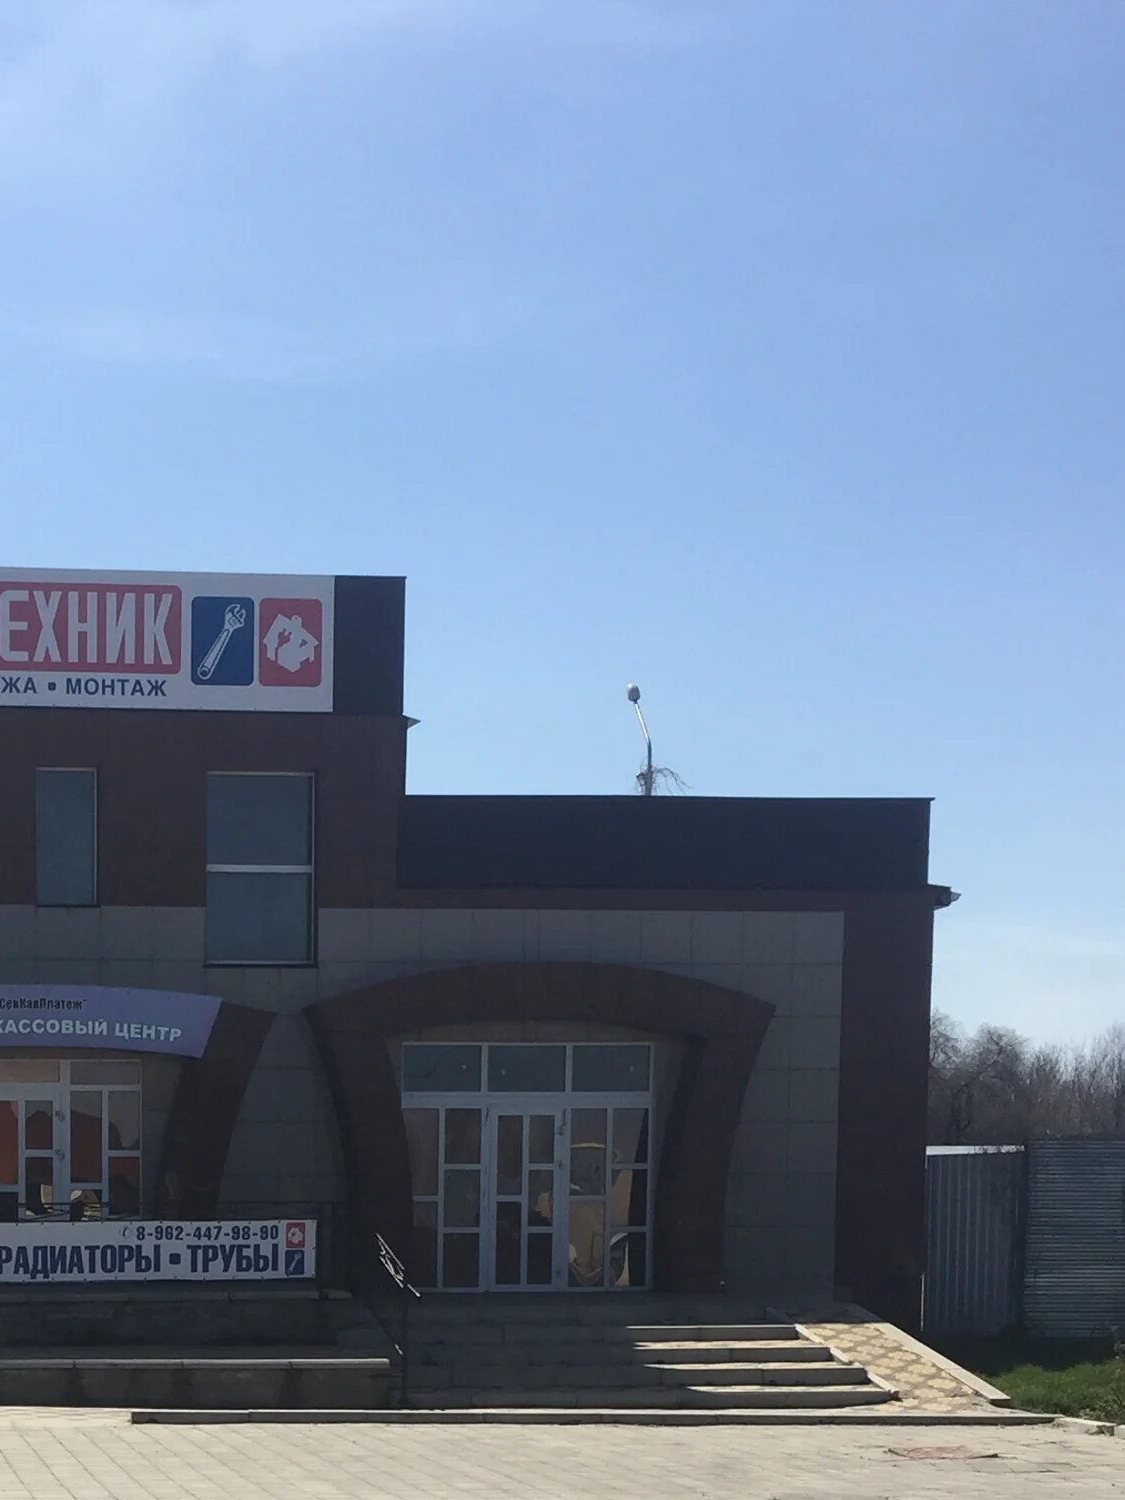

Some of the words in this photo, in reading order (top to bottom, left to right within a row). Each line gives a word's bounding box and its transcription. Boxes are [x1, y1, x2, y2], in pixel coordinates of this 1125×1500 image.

[66, 678, 167, 697] МОНТАЖ
[115, 1022, 182, 1043] ЦЕНТР
[186, 1243, 280, 1273] ТРУБЫ
